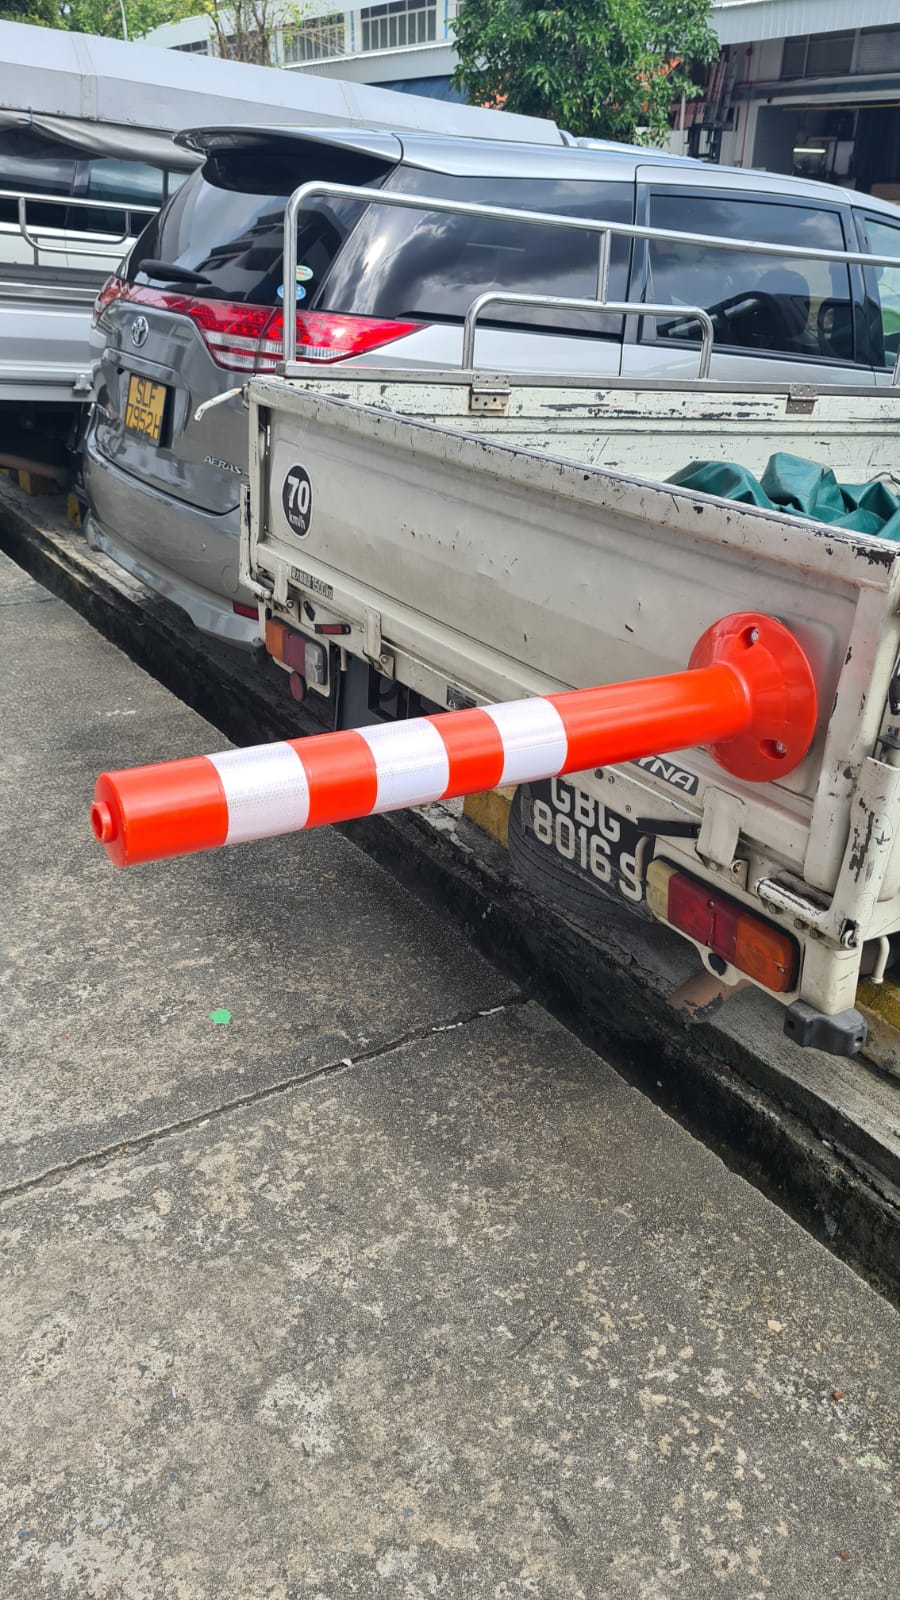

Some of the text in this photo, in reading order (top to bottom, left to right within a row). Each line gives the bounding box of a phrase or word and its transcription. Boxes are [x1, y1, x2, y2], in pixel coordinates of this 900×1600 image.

[136, 378, 158, 408] SLF
[128, 403, 160, 440] 7952H
[204, 456, 242, 474] AERAS
[287, 475, 310, 514] 70
[551, 777, 621, 843] GBG
[533, 800, 642, 902] 8016 S
